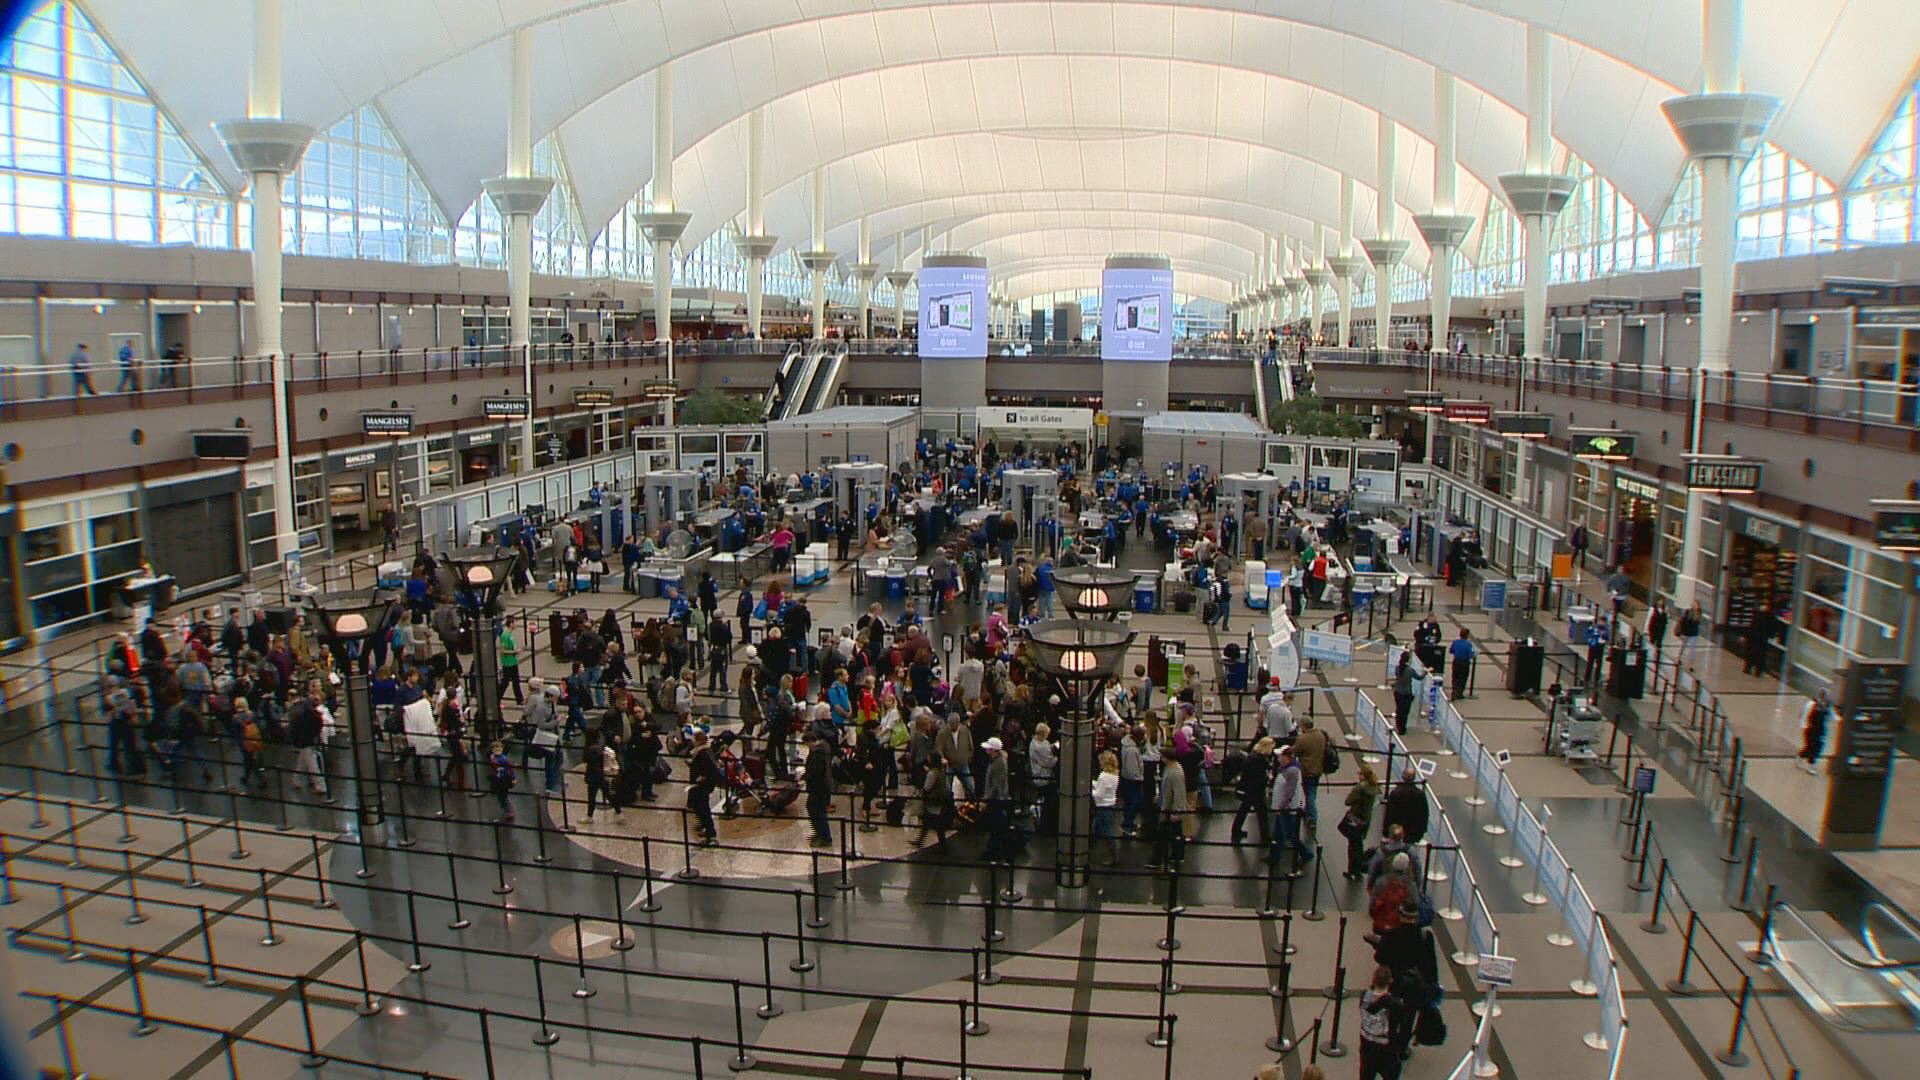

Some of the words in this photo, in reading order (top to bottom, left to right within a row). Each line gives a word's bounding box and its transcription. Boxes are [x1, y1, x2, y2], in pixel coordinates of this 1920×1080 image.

[486, 402, 525, 410] MANGELSEN
[366, 416, 409, 426] MANGELSEN
[1019, 414, 1028, 423] to
[1030, 414, 1039, 423] all
[1040, 414, 1063, 424] Gates
